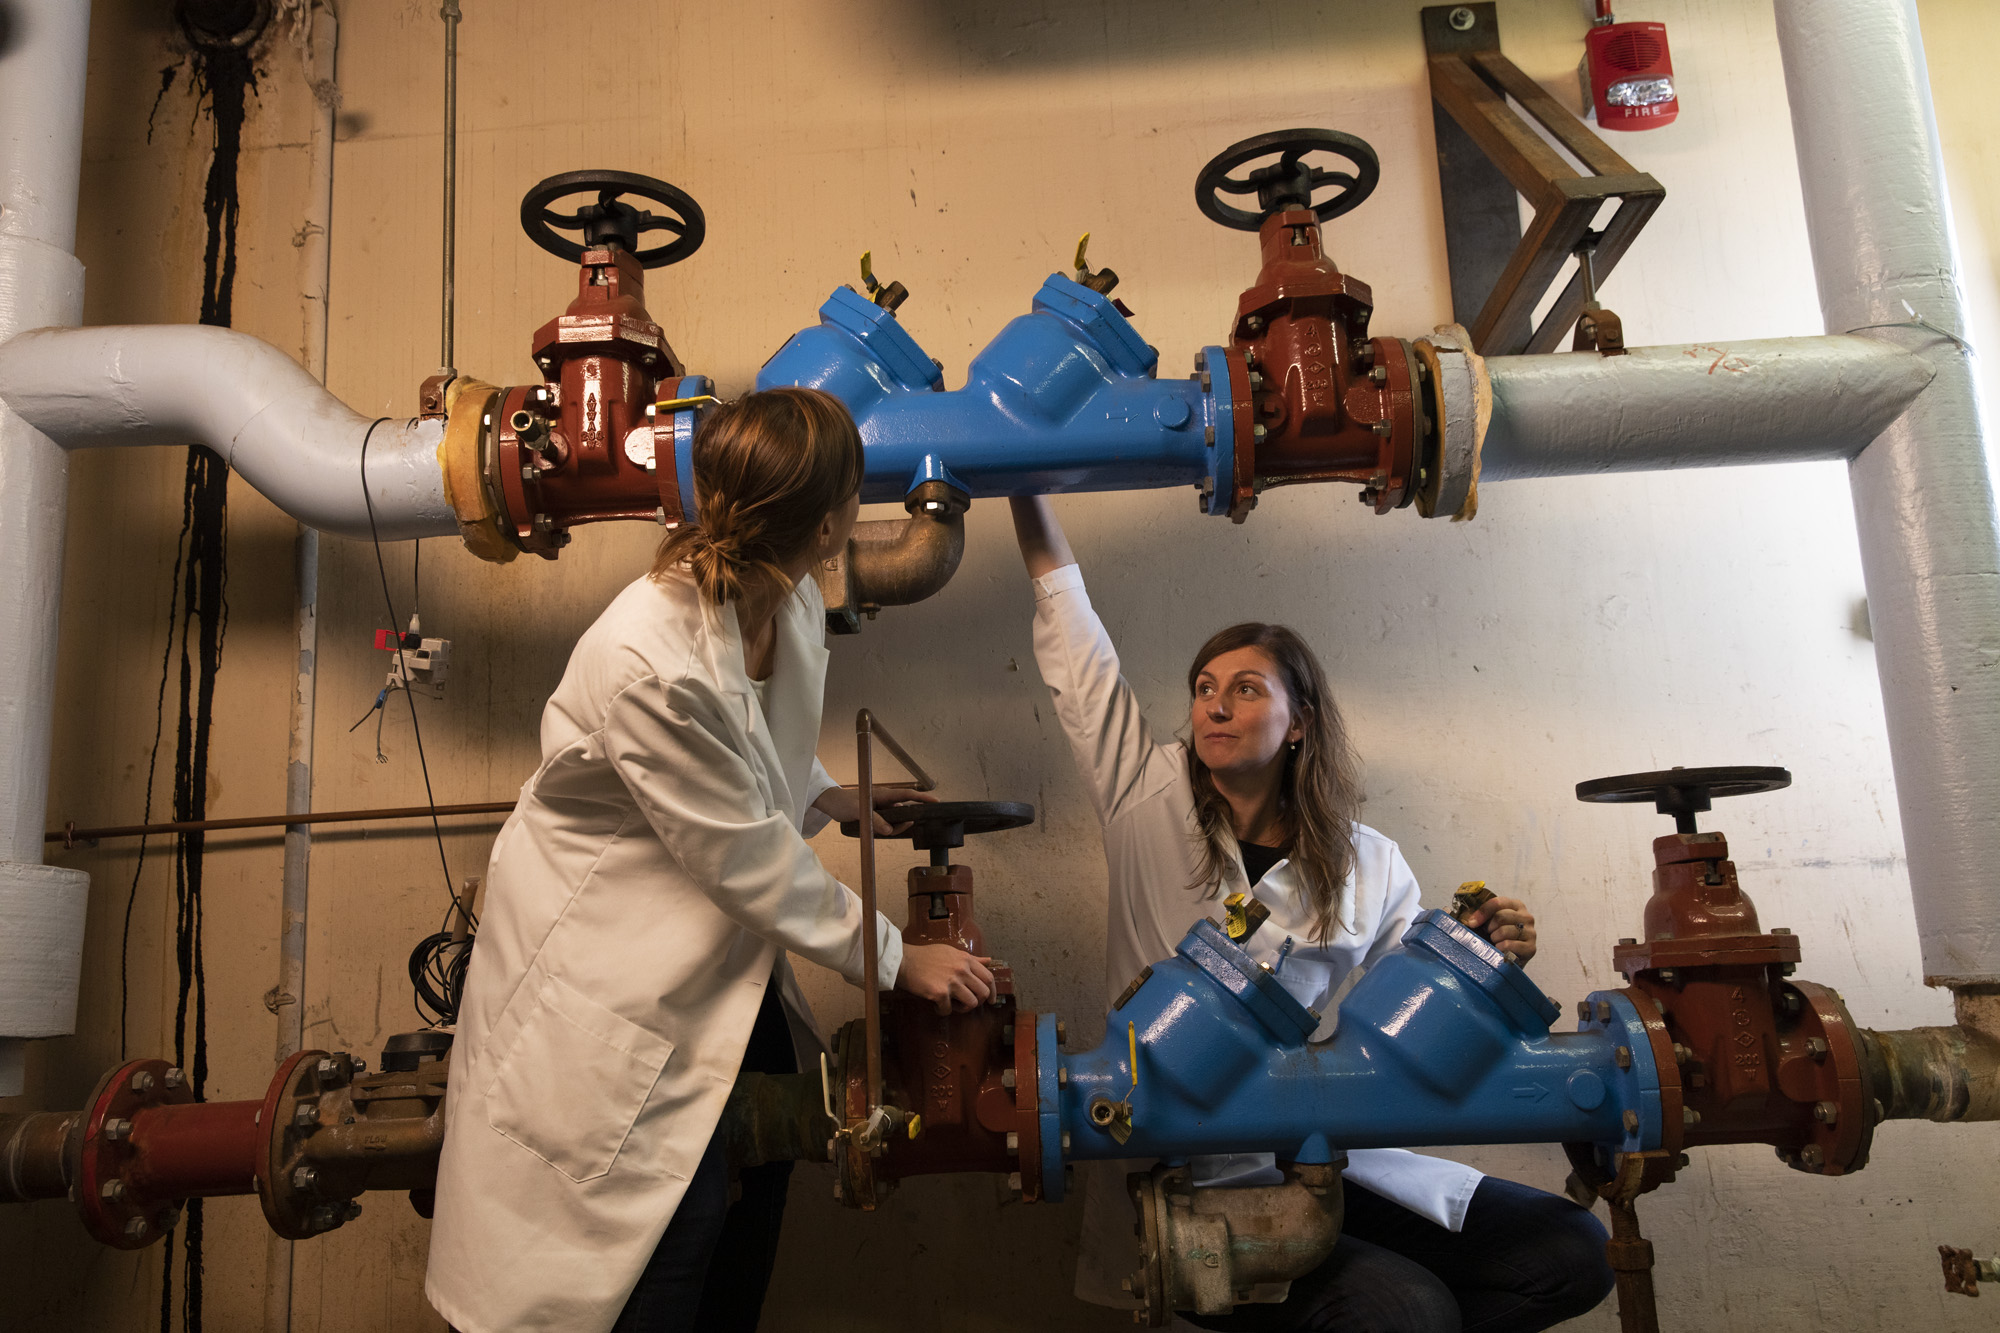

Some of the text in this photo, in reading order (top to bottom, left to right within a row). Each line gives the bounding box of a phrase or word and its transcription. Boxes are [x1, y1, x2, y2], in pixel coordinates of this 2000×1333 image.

[1624, 106, 1661, 118] FIRE
[1306, 323, 1317, 336] 4
[586, 392, 598, 431] AWWA
[1732, 986, 1745, 1002] 4
[364, 1134, 388, 1145] FLOW
